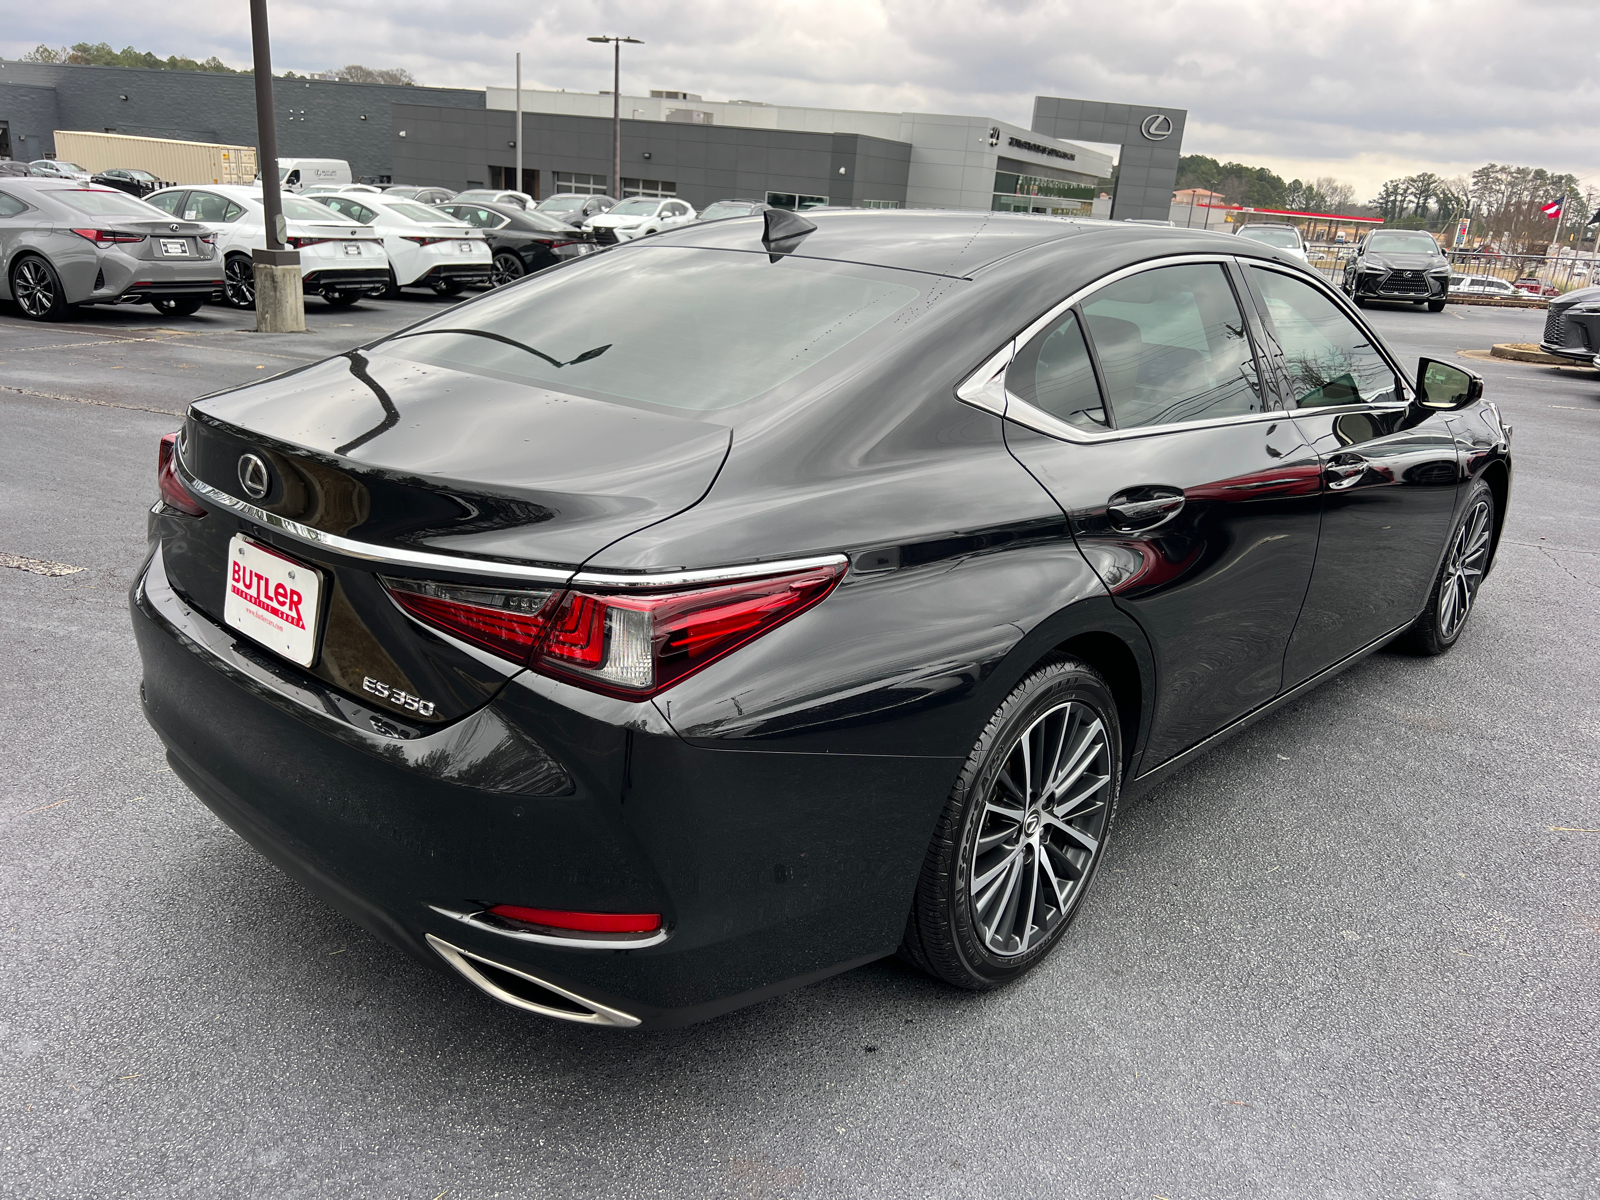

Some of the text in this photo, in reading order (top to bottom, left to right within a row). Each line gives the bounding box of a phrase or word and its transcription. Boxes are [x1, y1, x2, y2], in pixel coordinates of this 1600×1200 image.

[232, 584, 304, 629] AUTOMOTIVE GROUP
[245, 607, 284, 633] www.butlercars.com
[362, 676, 436, 717] ES 350
[958, 797, 981, 884] Sport
